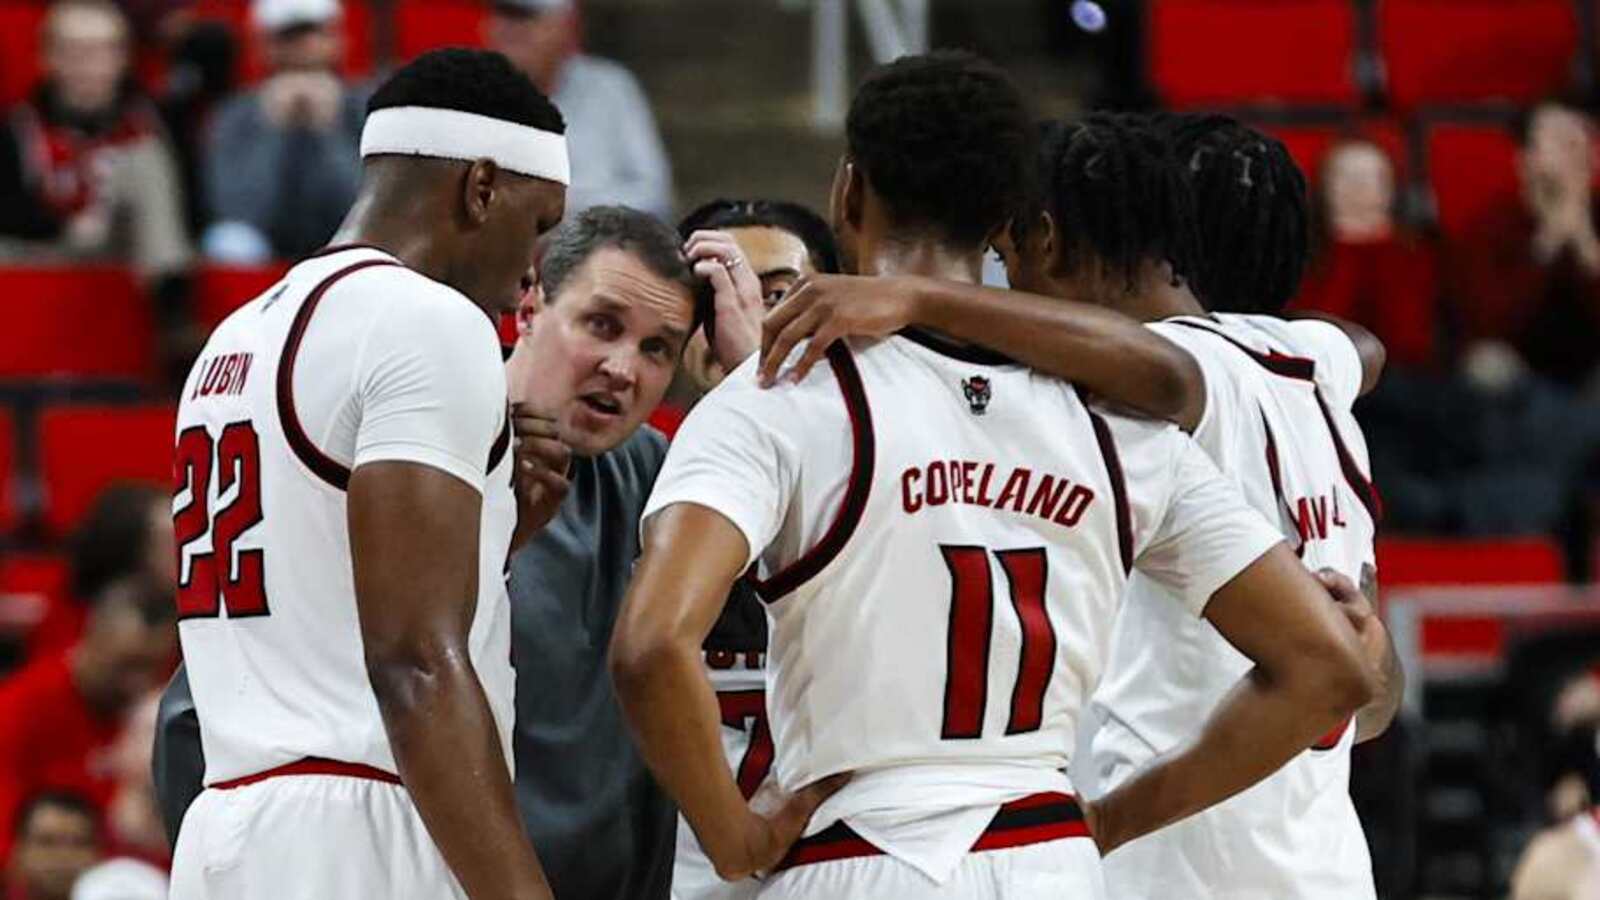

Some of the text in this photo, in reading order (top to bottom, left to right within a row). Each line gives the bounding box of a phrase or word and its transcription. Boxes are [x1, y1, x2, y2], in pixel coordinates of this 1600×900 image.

[191, 352, 253, 401] LUBIN
[173, 419, 271, 619] 22
[902, 460, 1095, 528] COPELAND
[938, 543, 1057, 740] 11
